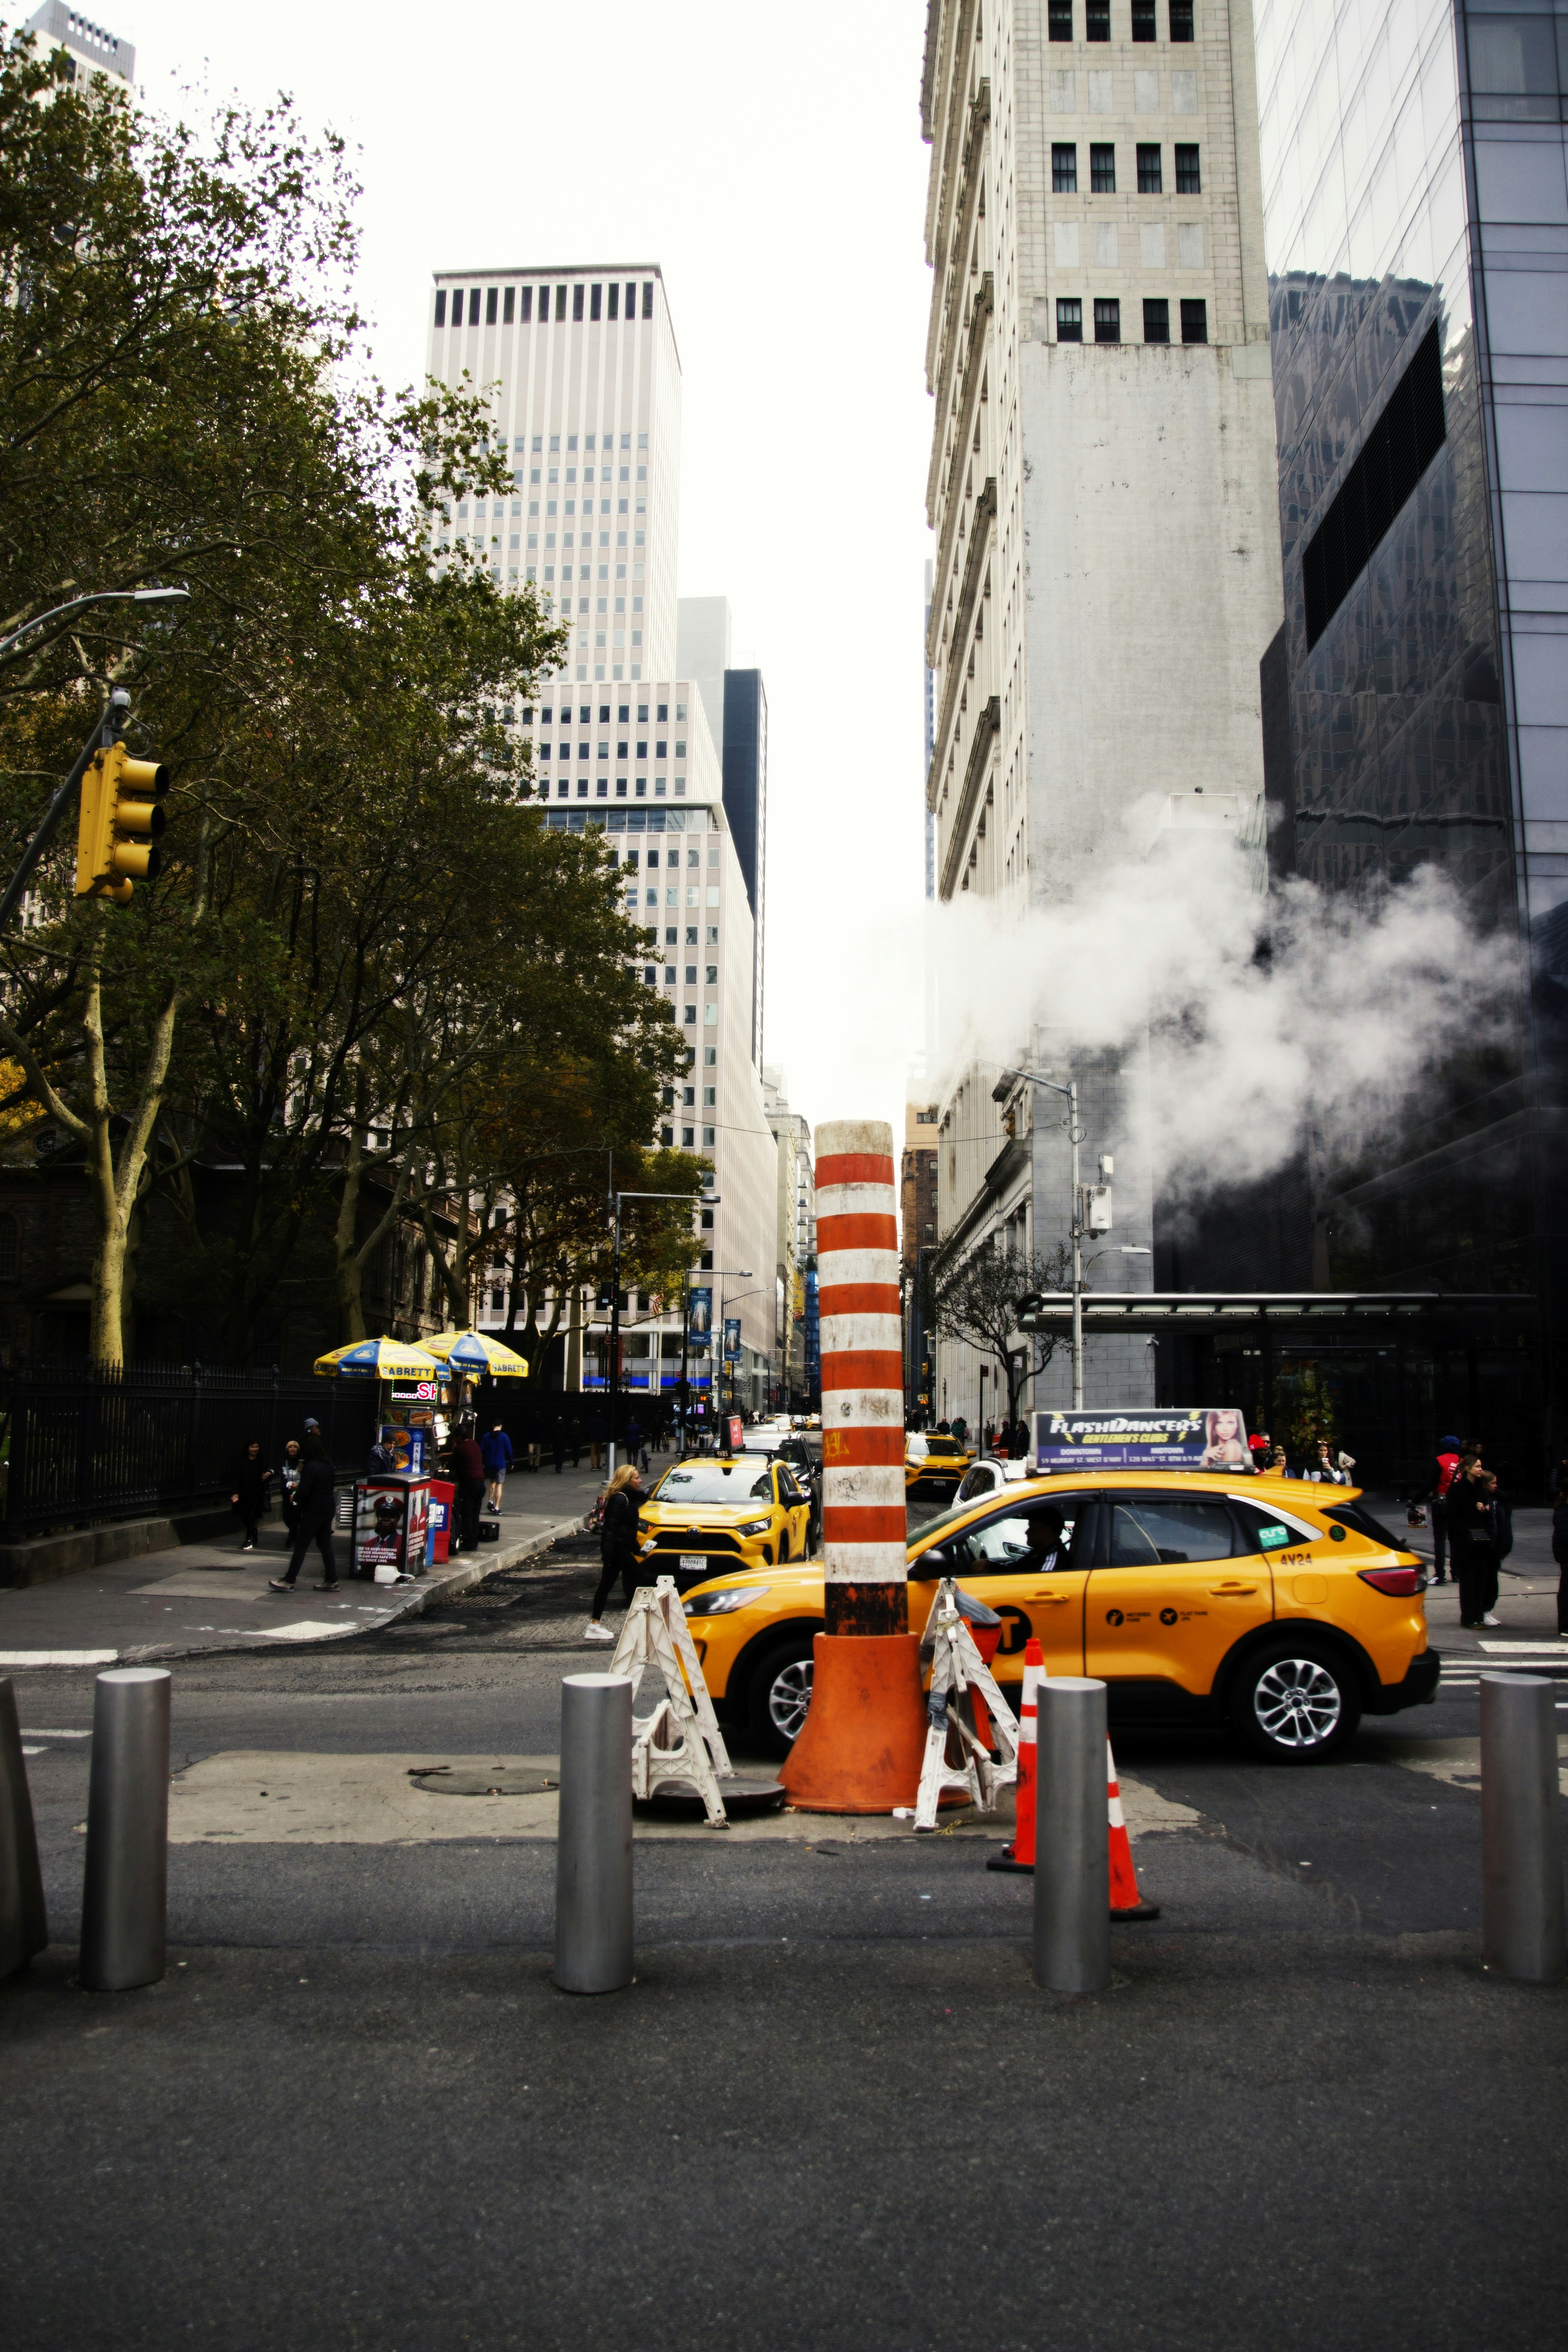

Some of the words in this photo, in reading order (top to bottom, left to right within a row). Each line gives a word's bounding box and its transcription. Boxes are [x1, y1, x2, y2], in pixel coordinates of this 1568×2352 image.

[382, 1367, 431, 1377] SABRETT
[492, 1364, 525, 1373] SABRETT
[1050, 1418, 1203, 1433] FLASHDANCERS
[1082, 1433, 1140, 1444] GENTLEMEN'S
[1139, 1433, 1170, 1443] CLUBS
[1259, 1526, 1287, 1539] curb
[1281, 1553, 1313, 1566] 4V24
[1001, 1617, 1020, 1648] T
